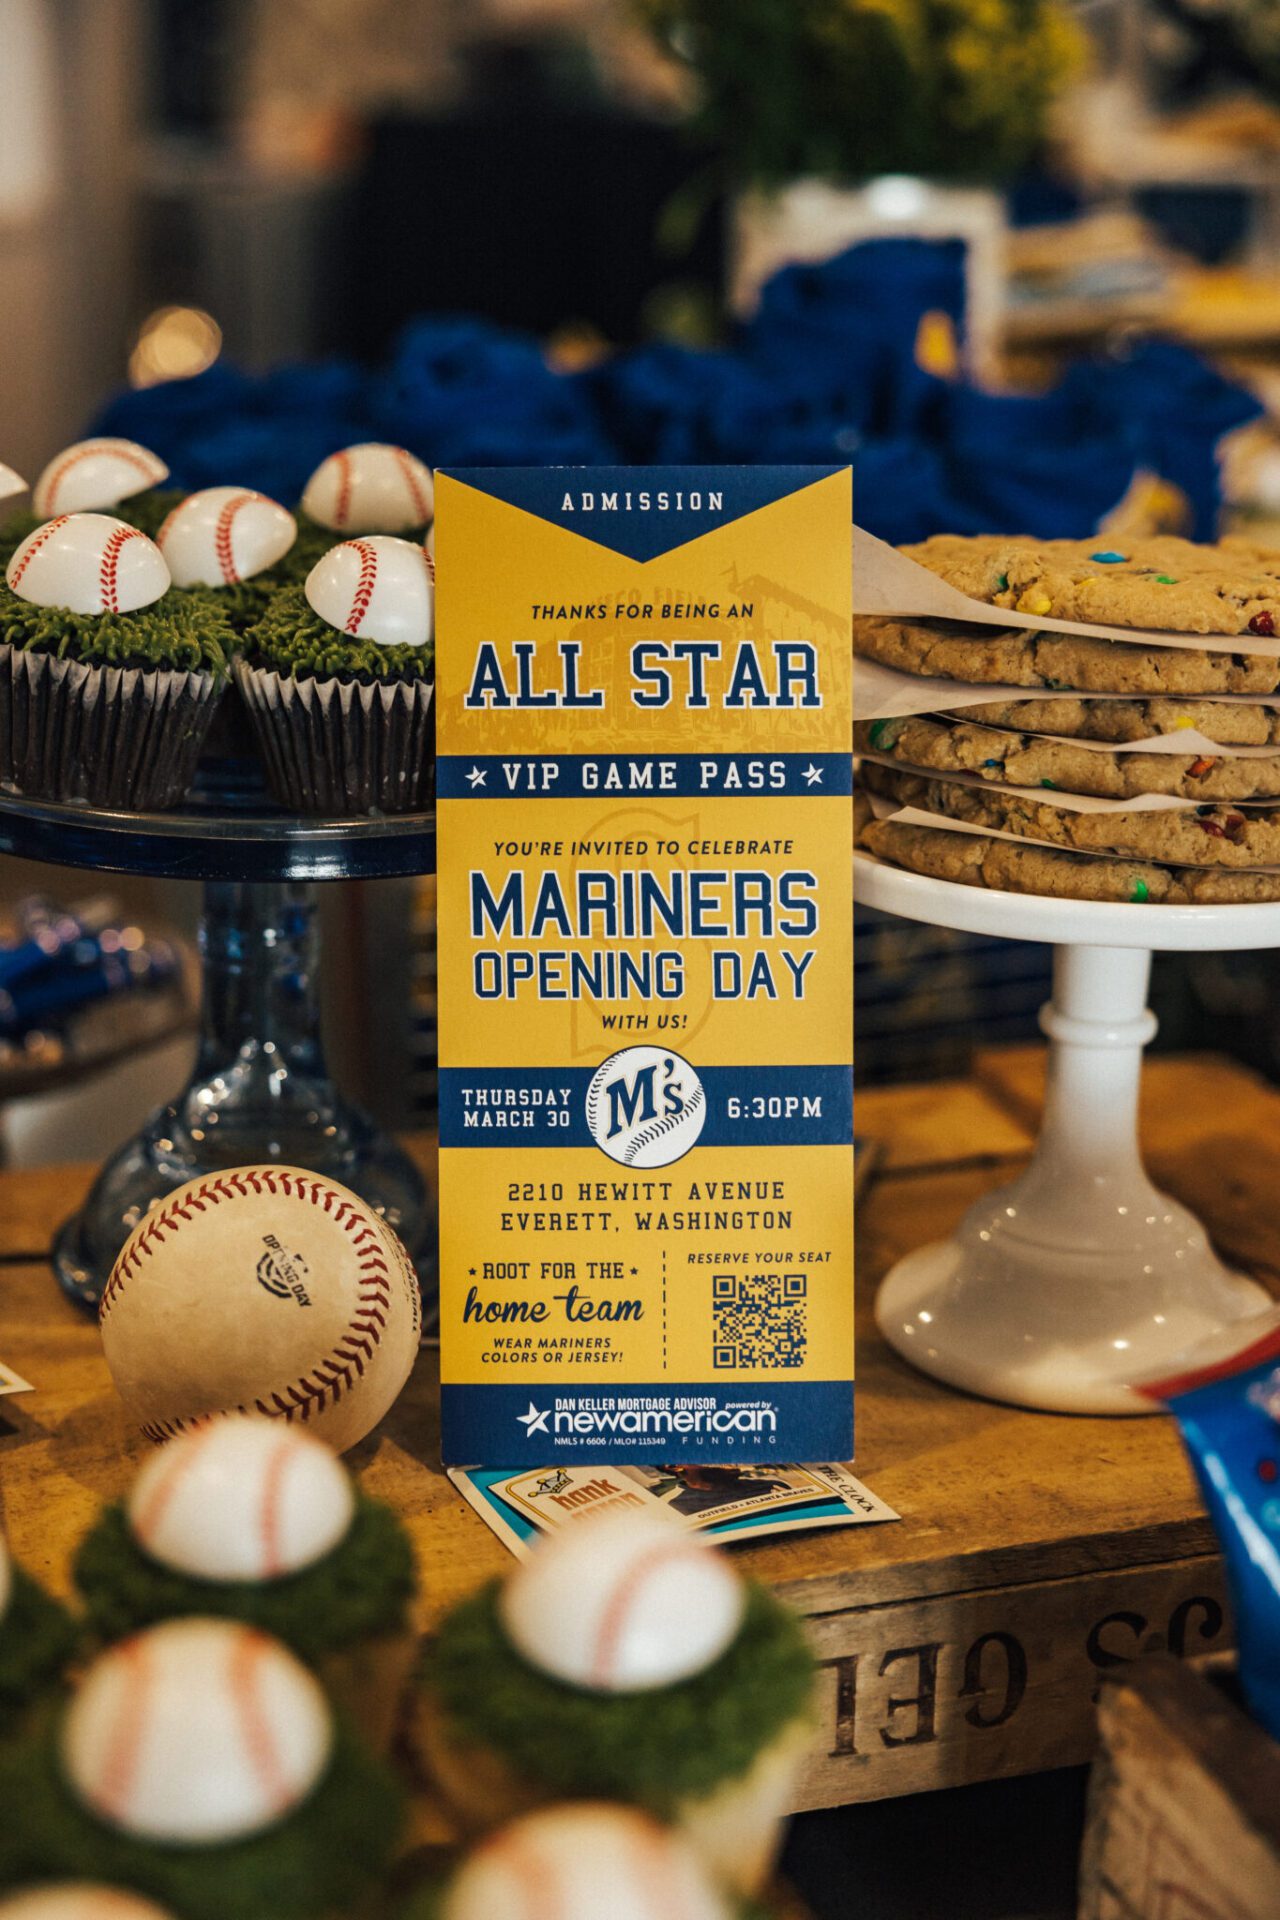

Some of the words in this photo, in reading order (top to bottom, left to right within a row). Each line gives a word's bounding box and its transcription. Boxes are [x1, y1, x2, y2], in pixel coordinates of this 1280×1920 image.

[562, 492, 722, 510] ADMISSION
[532, 605, 607, 619] THANKS
[615, 604, 653, 619] FOR
[662, 604, 719, 618] BEING
[727, 604, 753, 618] AN
[464, 641, 605, 709] ALL
[630, 640, 823, 709] STAR
[503, 763, 558, 789] VIP
[583, 762, 676, 789] GAME
[700, 762, 785, 788] PASS
[495, 842, 563, 856] YOU'RE
[572, 841, 648, 855] INVITED
[657, 841, 679, 855] TO
[688, 840, 793, 855] CELEBRATE
[470, 870, 819, 941] MARINERS
[473, 950, 684, 1000] OPENING
[712, 950, 816, 1000] DAY
[602, 1015, 648, 1029] WITH
[658, 1015, 687, 1029] US!
[462, 1089, 571, 1105] THURSDAY
[728, 1097, 821, 1118] 6:30PM
[464, 1111, 534, 1127] MARCH
[548, 1111, 569, 1126] 30
[509, 1184, 562, 1201] 2210
[579, 1183, 672, 1200] HEWITT
[688, 1182, 784, 1200] AVENUE
[501, 1213, 618, 1232] EVERETT,
[635, 1211, 791, 1230] WASHINGTON
[688, 1253, 749, 1264] RESERVE
[755, 1253, 793, 1263] YOUR
[799, 1252, 831, 1262] SEAT
[483, 1263, 530, 1279] ROOT
[541, 1263, 576, 1279] FOR
[586, 1263, 624, 1279] THE
[292, 1284, 312, 1307] DAY
[463, 1286, 550, 1324] home
[554, 1286, 644, 1322] team
[494, 1338, 532, 1348] WEAR
[538, 1338, 610, 1348] MARINERS
[482, 1352, 537, 1363] COLORS
[543, 1352, 562, 1362] OR
[568, 1352, 623, 1362] JERSEY!
[555, 1398, 577, 1411] DAN
[578, 1398, 615, 1411] KELLER
[618, 1398, 671, 1411] MORTGAGE
[673, 1398, 716, 1410] ADVISOR
[724, 1402, 759, 1410] powered
[760, 1402, 772, 1410] by
[555, 1437, 577, 1445] NMLS
[586, 1437, 606, 1445] 6606
[682, 1436, 776, 1444] FUNDING
[549, 1479, 622, 1511] hank
[698, 1503, 740, 1519] OUTFIELD
[745, 1494, 781, 1506] ATLANTA
[783, 1487, 815, 1498] BRAVES
[838, 1483, 877, 1513] CLOCK
